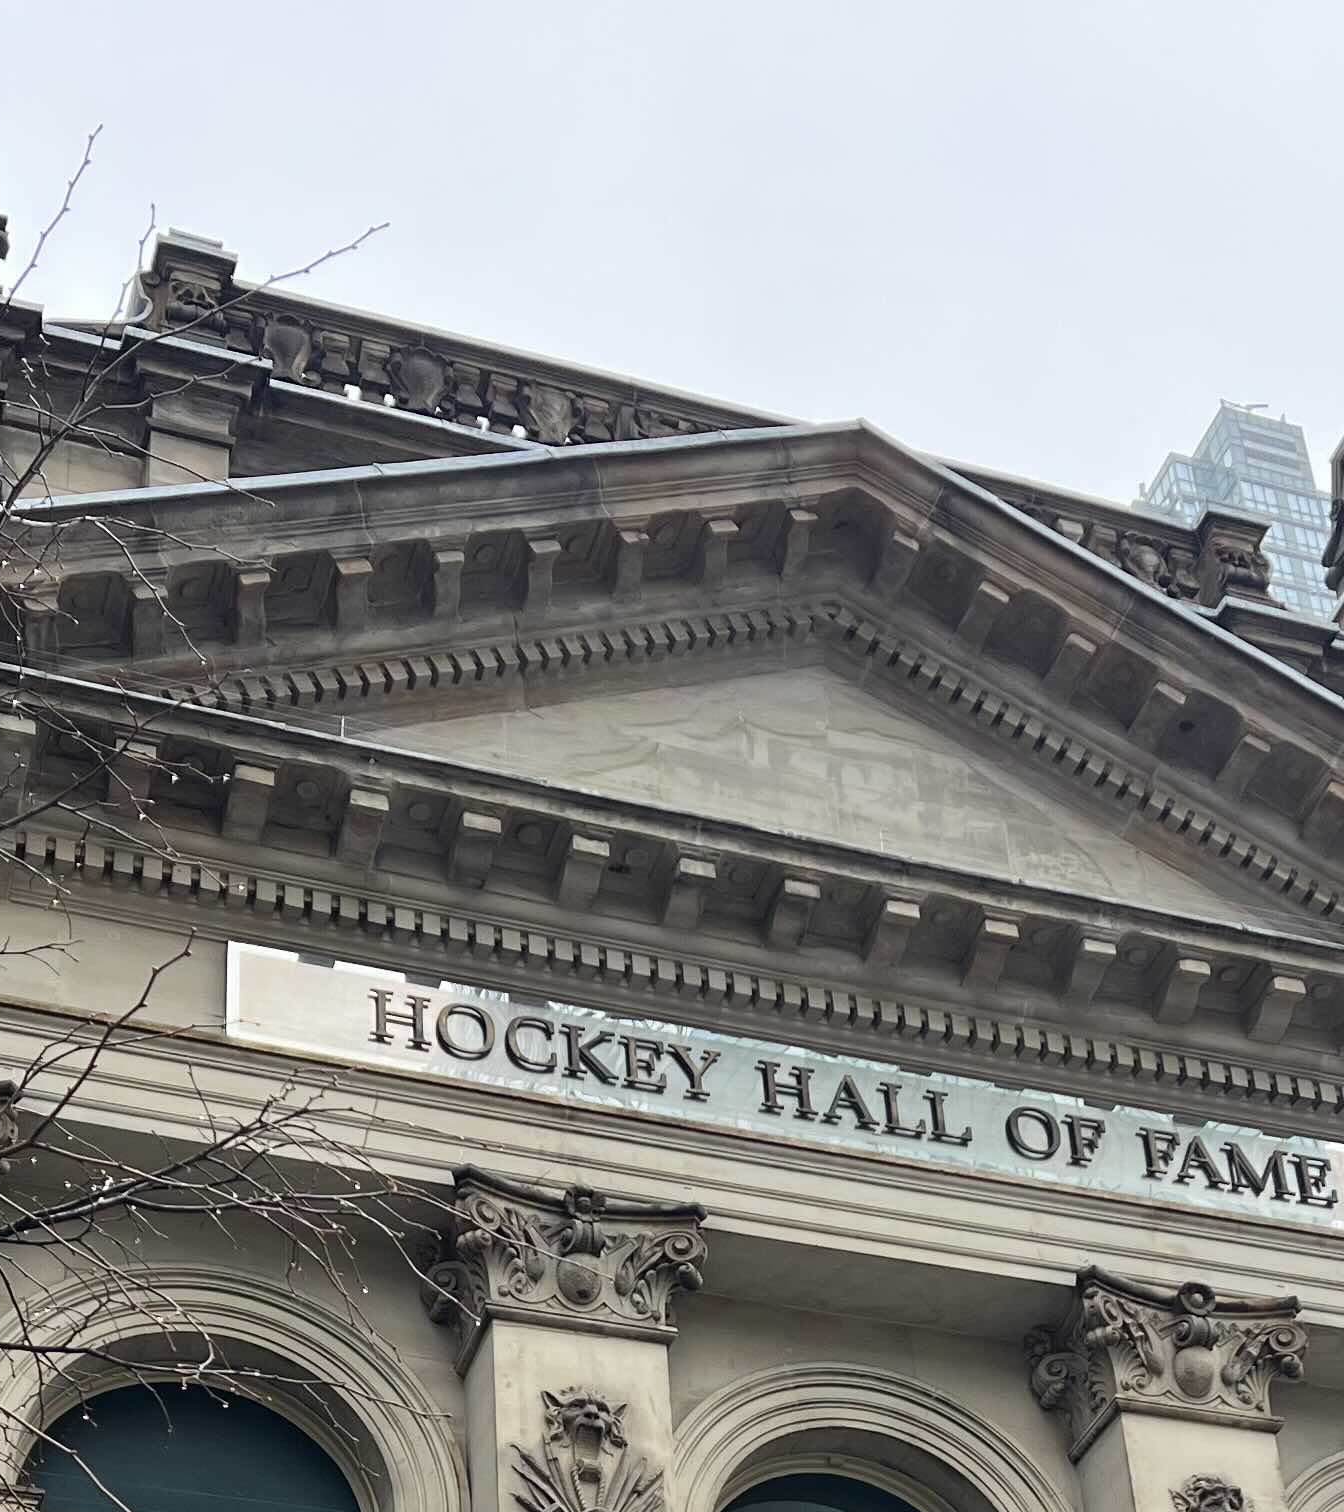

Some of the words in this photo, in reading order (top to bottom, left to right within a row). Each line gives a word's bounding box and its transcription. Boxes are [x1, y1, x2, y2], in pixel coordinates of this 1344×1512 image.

[367, 987, 722, 1101] HOCKEY
[755, 1058, 973, 1147] HALL
[1005, 1105, 1106, 1167] OF
[1135, 1124, 1339, 1209] FAME
